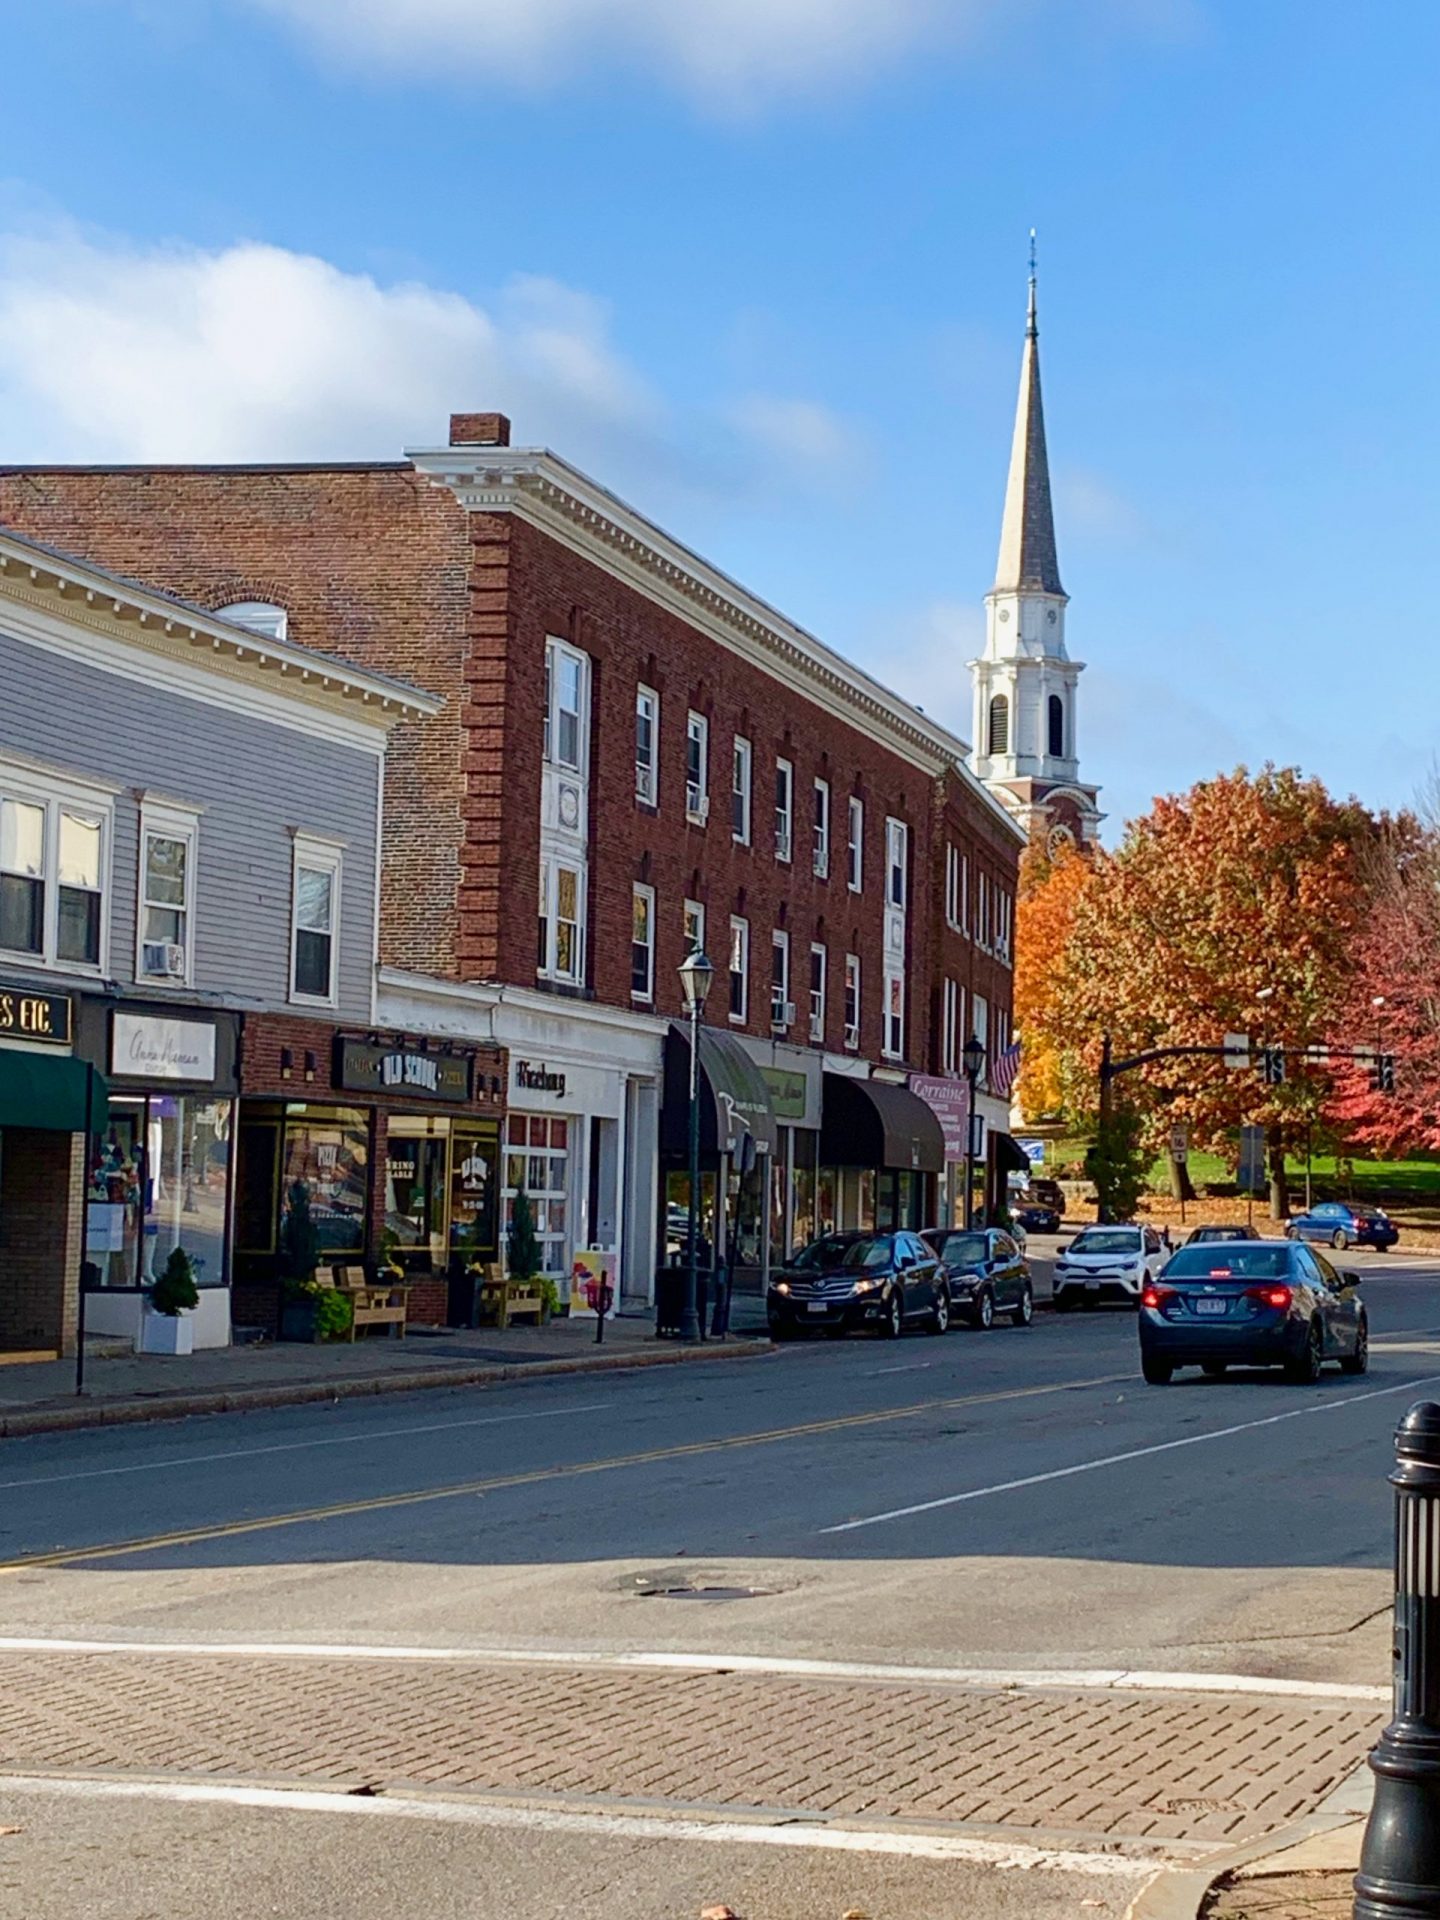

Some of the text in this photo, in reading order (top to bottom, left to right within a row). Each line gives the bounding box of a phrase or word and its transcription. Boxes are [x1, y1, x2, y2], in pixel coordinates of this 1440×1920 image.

[20, 998, 53, 1034] ETC.
[383, 1054, 402, 1086] OLD
[404, 1054, 437, 1092] SCHOOL
